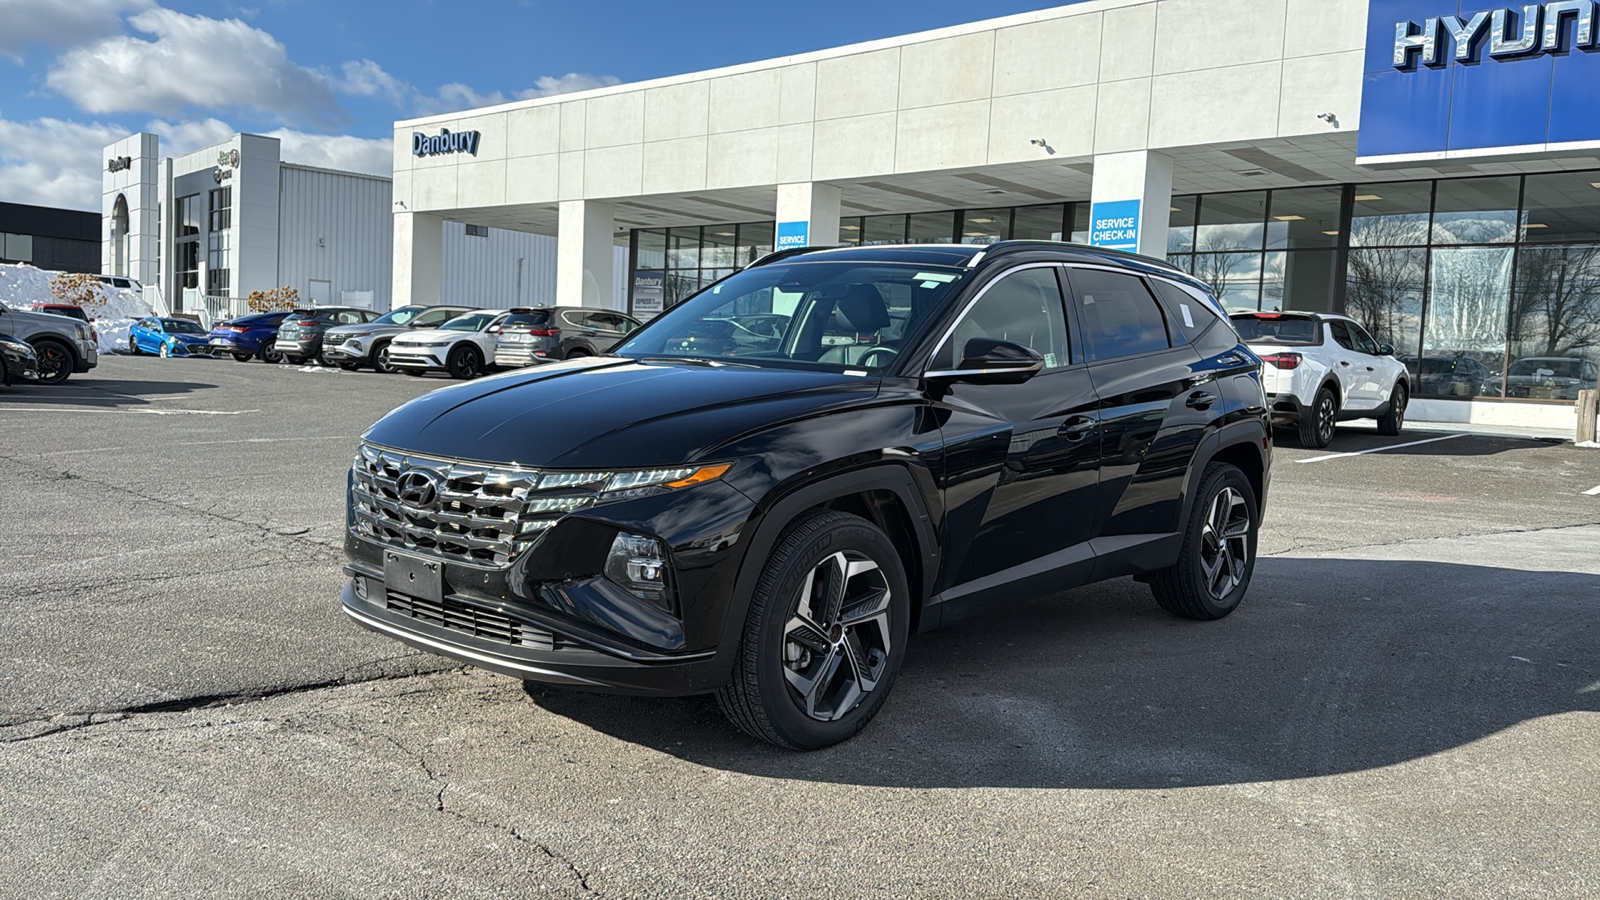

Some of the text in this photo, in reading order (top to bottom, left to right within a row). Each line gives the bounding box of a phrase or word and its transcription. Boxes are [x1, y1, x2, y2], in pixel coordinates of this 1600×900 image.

[1393, 0, 1600, 70] HYUN
[412, 127, 481, 157] Danbury
[1096, 217, 1134, 229] SERVICE
[779, 235, 805, 244] SERVICE
[1093, 229, 1136, 241] CHECK-IN
[635, 277, 662, 287] Danbury
[785, 534, 831, 591] MICHELIN
